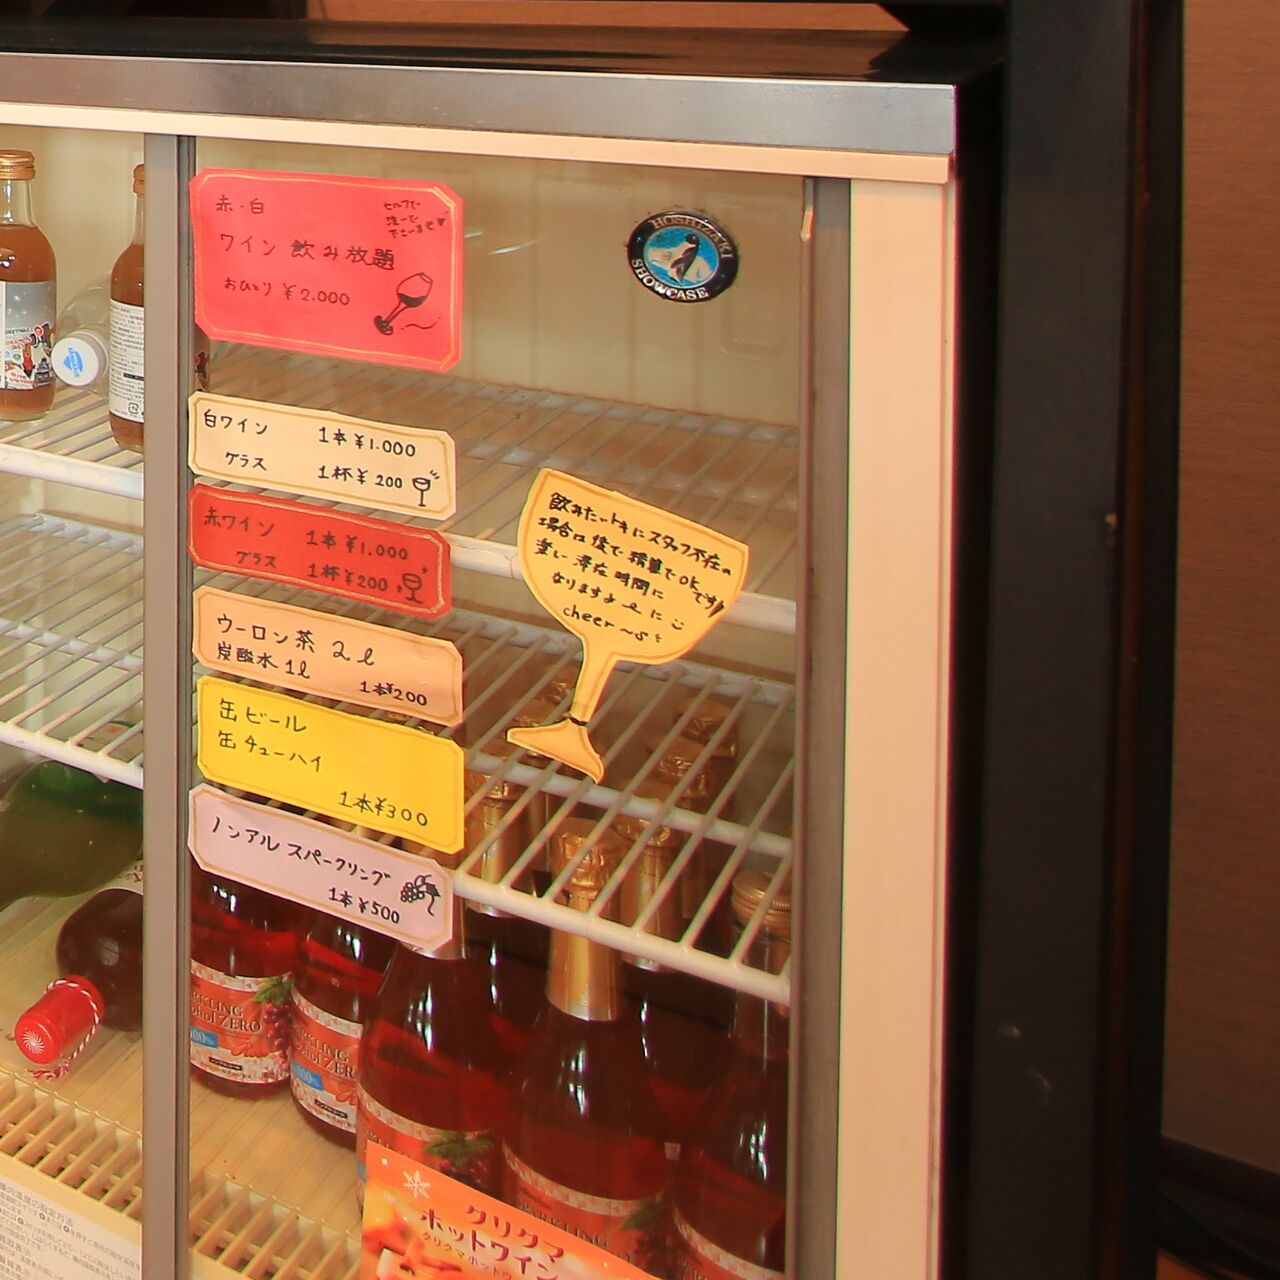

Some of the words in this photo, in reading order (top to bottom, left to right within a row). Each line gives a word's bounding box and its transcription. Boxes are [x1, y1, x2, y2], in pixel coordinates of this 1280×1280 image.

[220, 234, 277, 256] ワイン
[291, 240, 395, 270] 飲み放題
[631, 258, 709, 301] SHOWCASE
[203, 408, 269, 435] 白ワイン
[225, 451, 268, 470] グラス
[203, 506, 275, 537] 赤ワイン
[236, 551, 277, 569] グラス
[216, 614, 317, 654] ウーロン茶
[216, 641, 279, 670] 炭酸水
[218, 697, 308, 733] 缶ビール
[219, 1015, 263, 1033] ZERO
[324, 1057, 354, 1078] ZER
